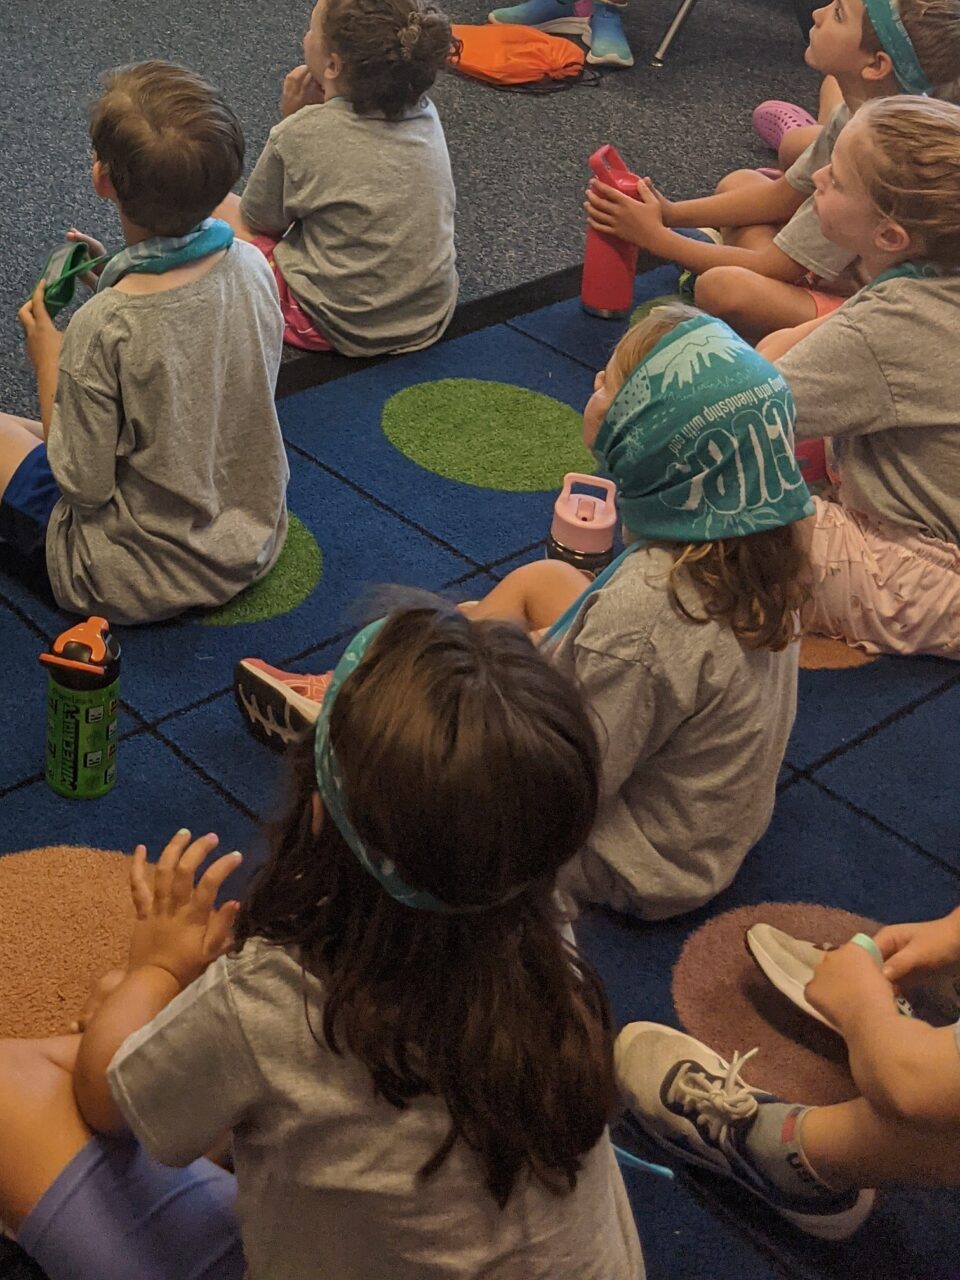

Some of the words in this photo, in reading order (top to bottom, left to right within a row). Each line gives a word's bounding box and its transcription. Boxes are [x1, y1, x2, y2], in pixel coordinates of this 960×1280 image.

[754, 385, 775, 400] into
[702, 390, 759, 422] friendship
[682, 415, 707, 440] with
